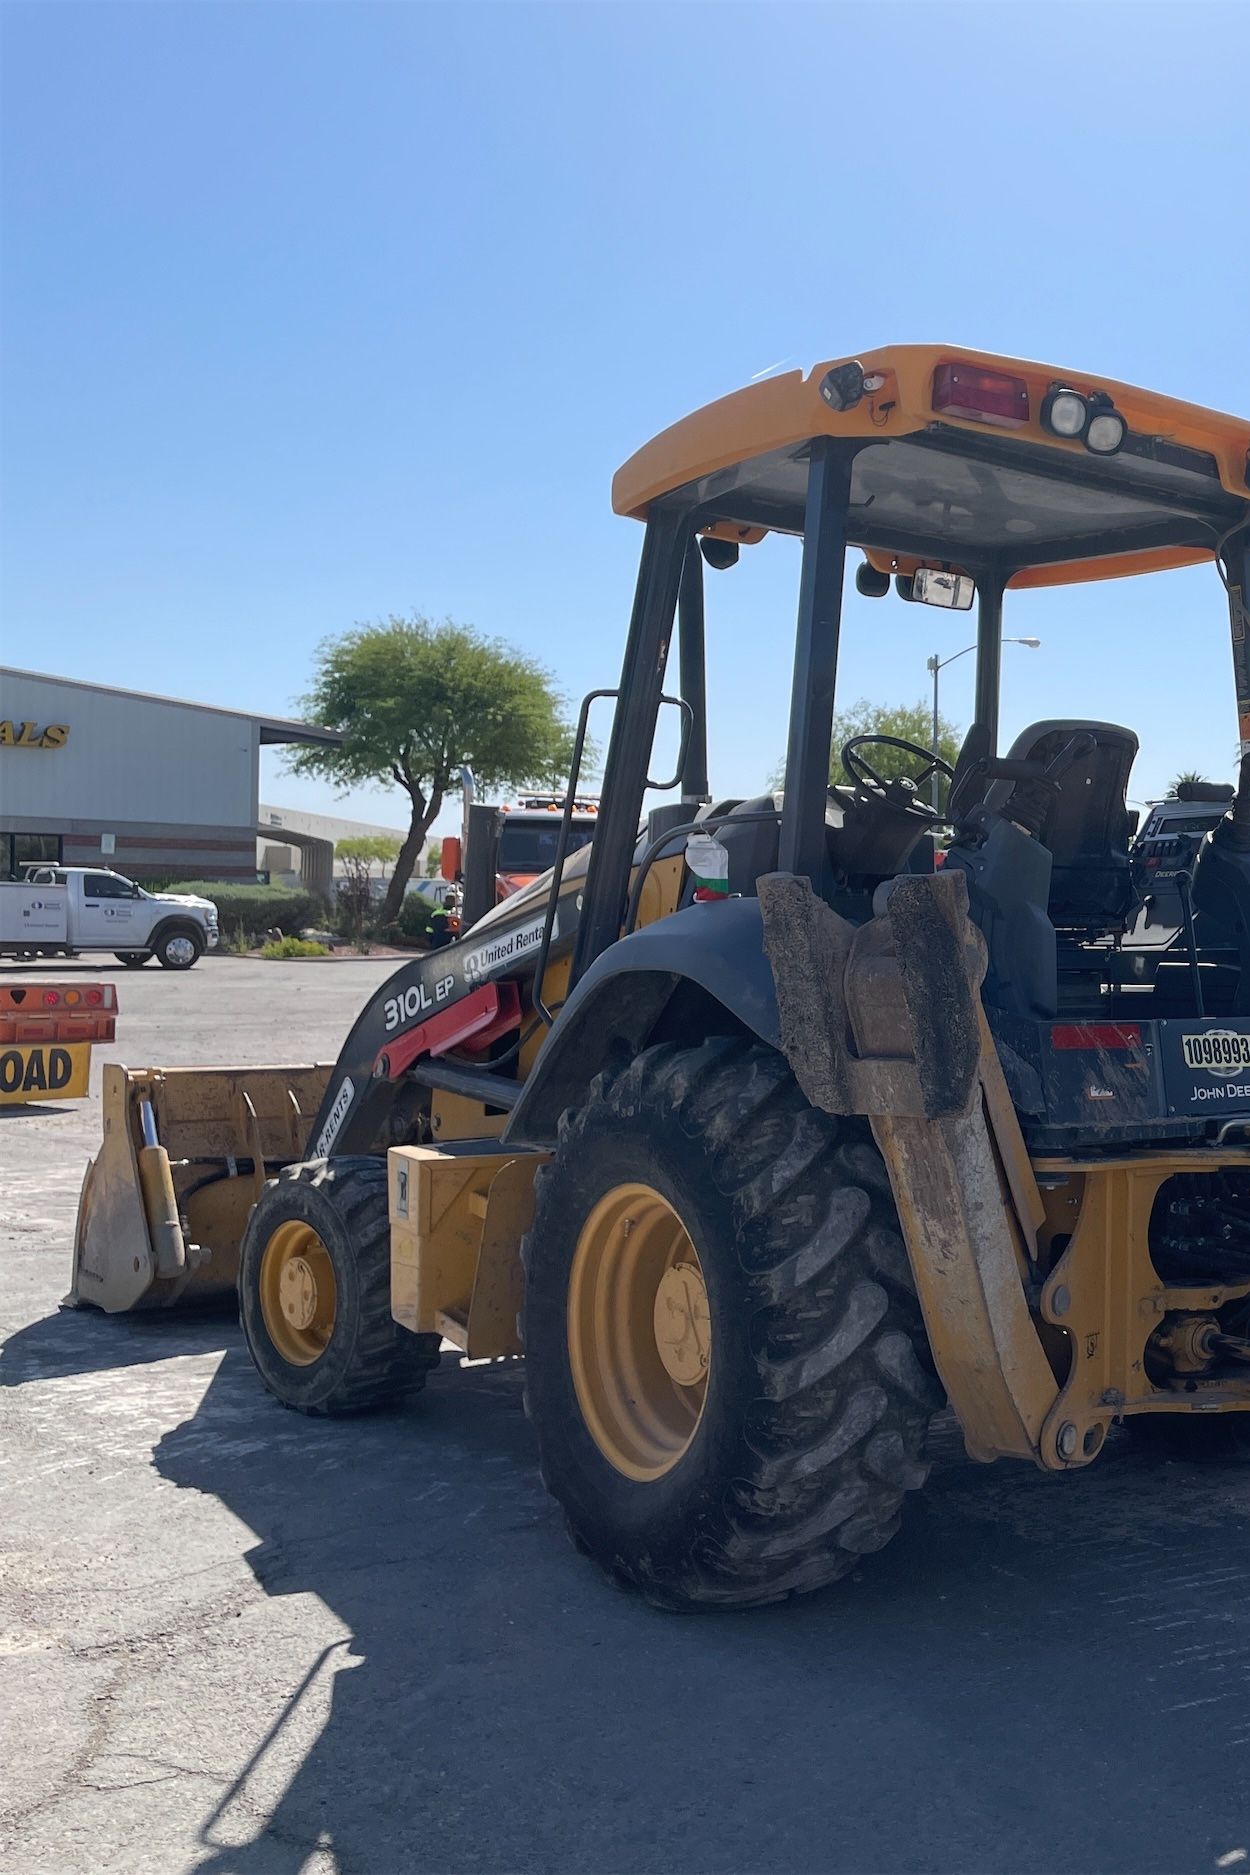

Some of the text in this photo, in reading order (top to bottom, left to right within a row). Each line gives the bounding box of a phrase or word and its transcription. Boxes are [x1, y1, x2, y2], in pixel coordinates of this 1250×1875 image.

[480, 926, 547, 967] United Renta
[383, 975, 455, 1031] 310L EP
[0, 1048, 73, 1093] OAD
[1190, 1086, 1225, 1101] JOHN
